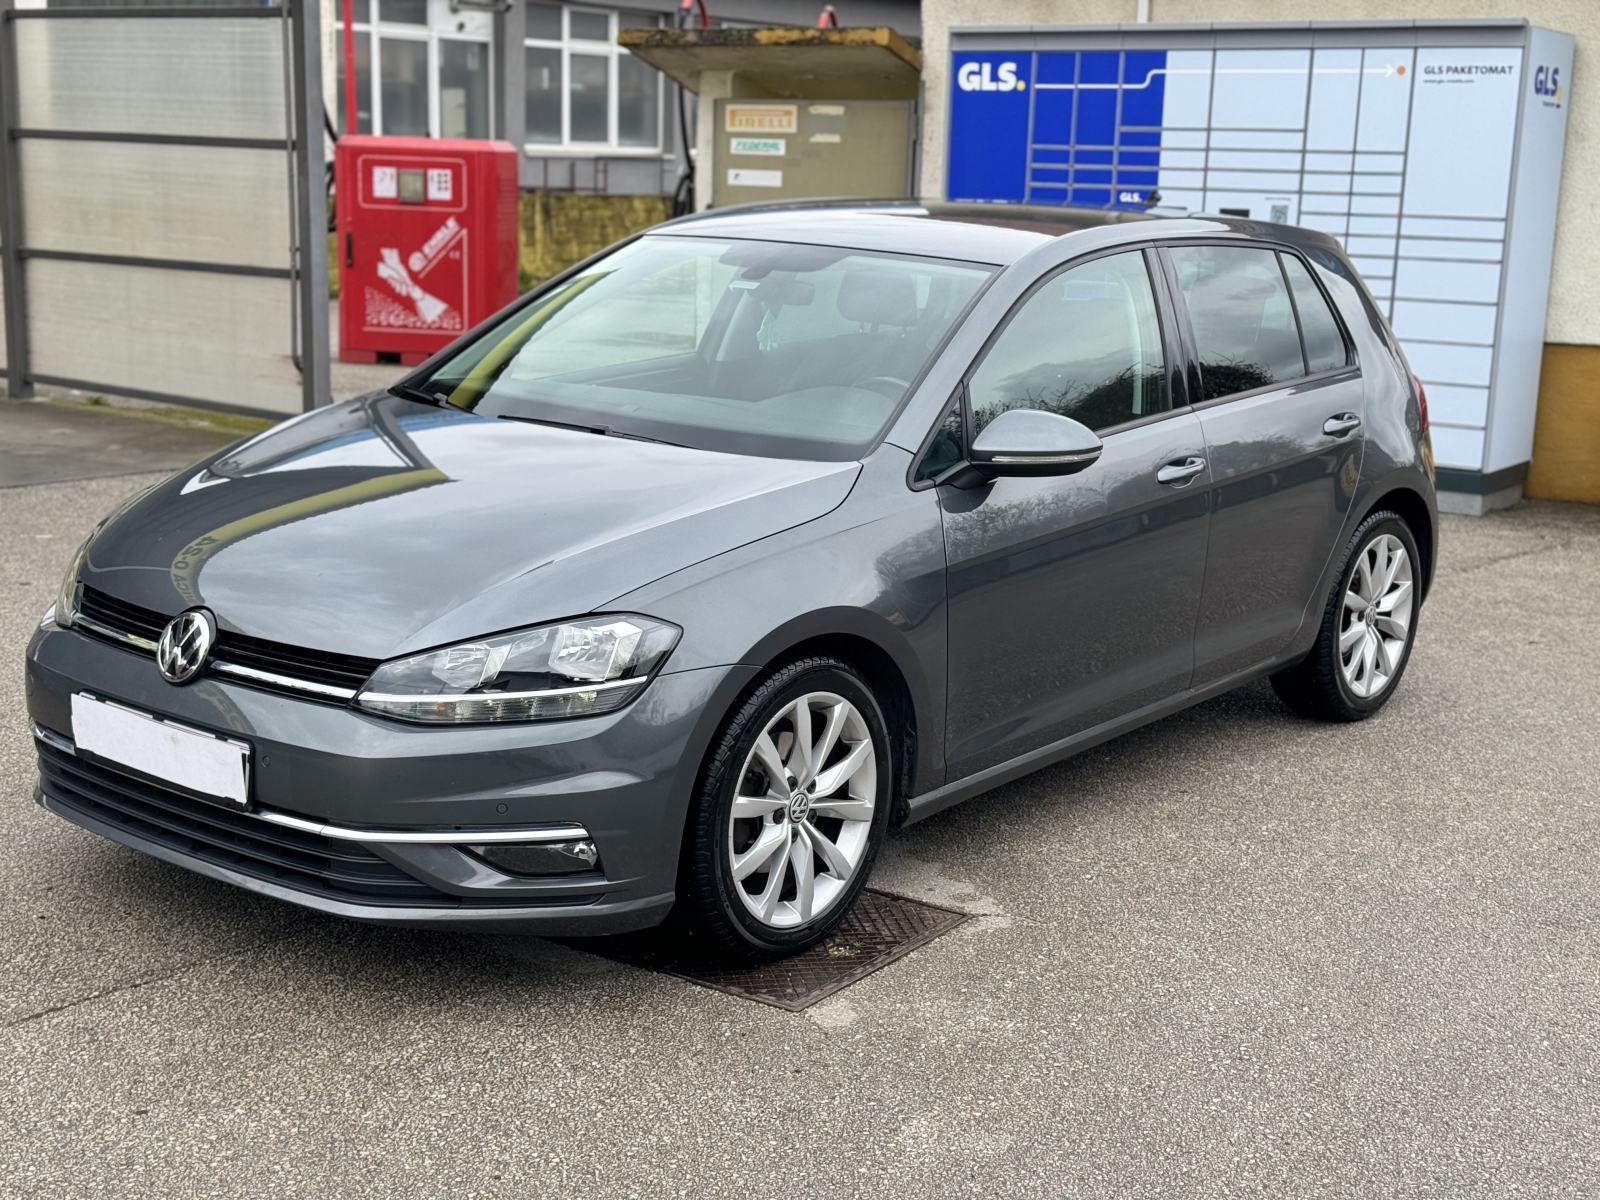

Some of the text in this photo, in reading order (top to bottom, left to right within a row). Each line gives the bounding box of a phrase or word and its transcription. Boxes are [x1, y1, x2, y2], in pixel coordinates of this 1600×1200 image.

[1423, 64, 1514, 75] GLS PAKETOMAT
[729, 109, 793, 129] PIRELLI
